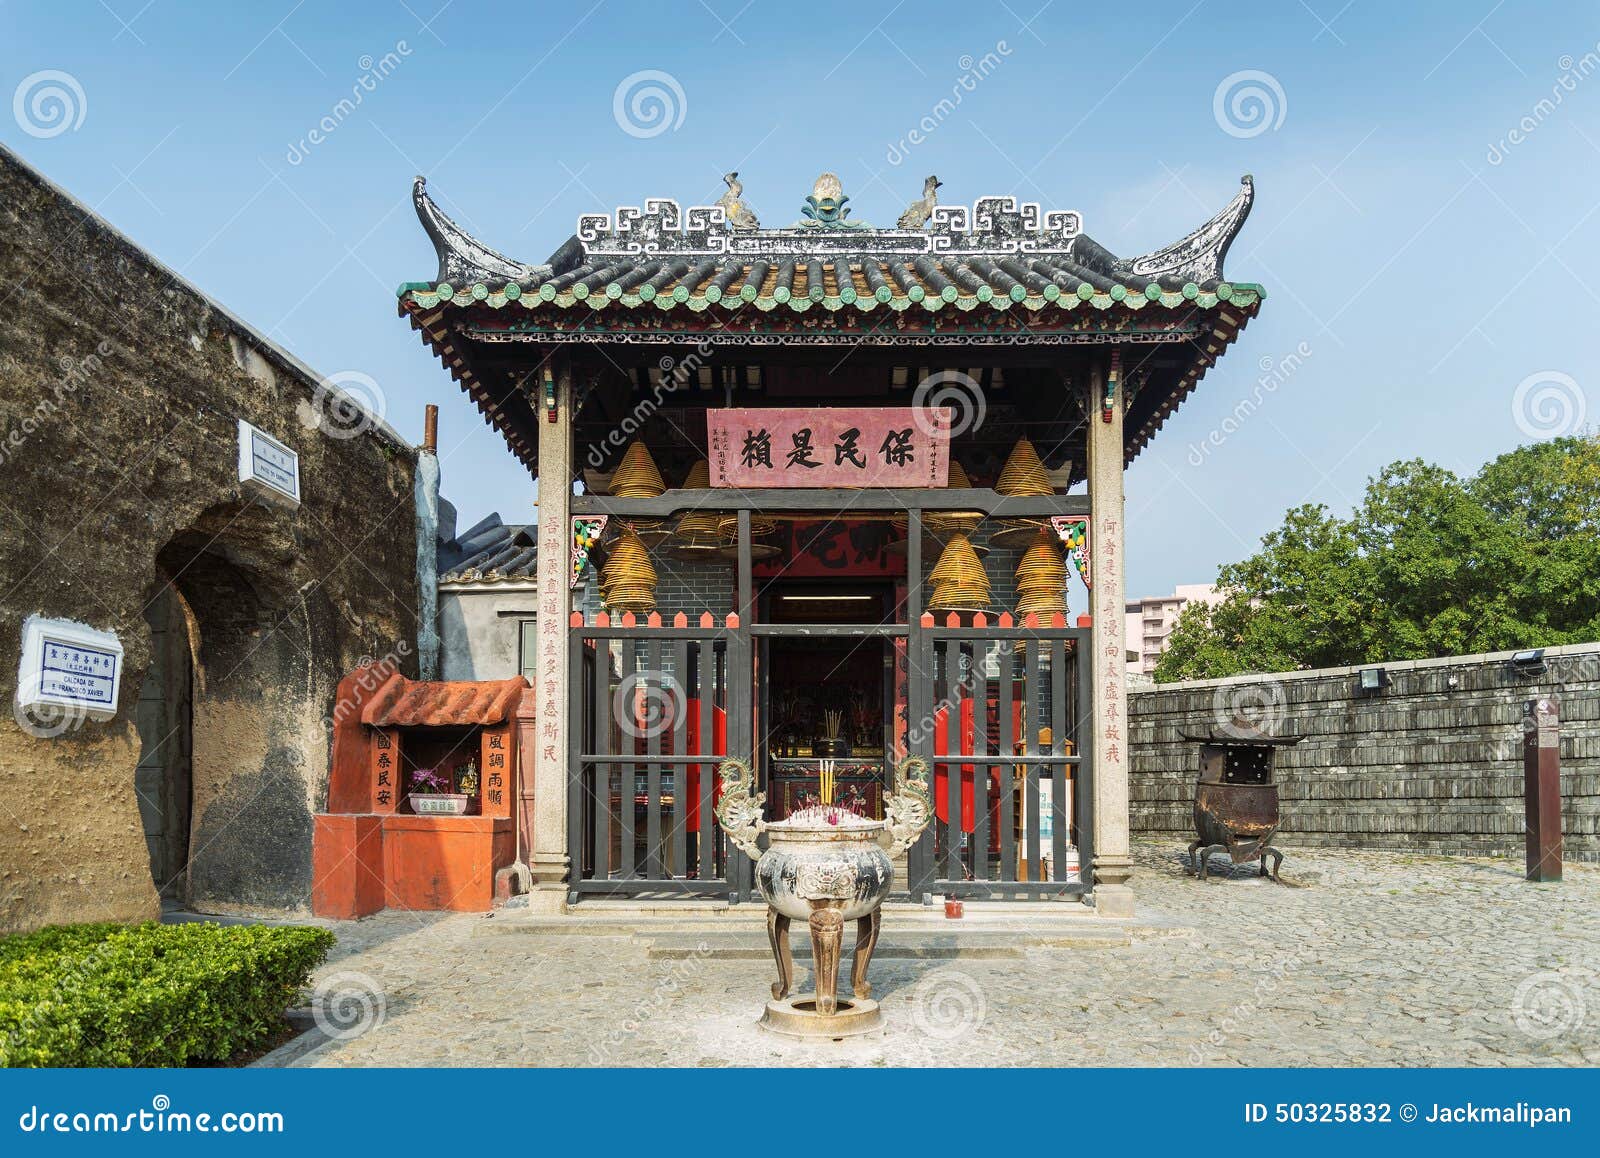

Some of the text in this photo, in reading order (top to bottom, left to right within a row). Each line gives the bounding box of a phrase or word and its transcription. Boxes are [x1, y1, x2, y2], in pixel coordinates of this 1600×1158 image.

[376, 734, 392, 805] 國泰民安
[488, 735, 504, 805] 風調雨順
